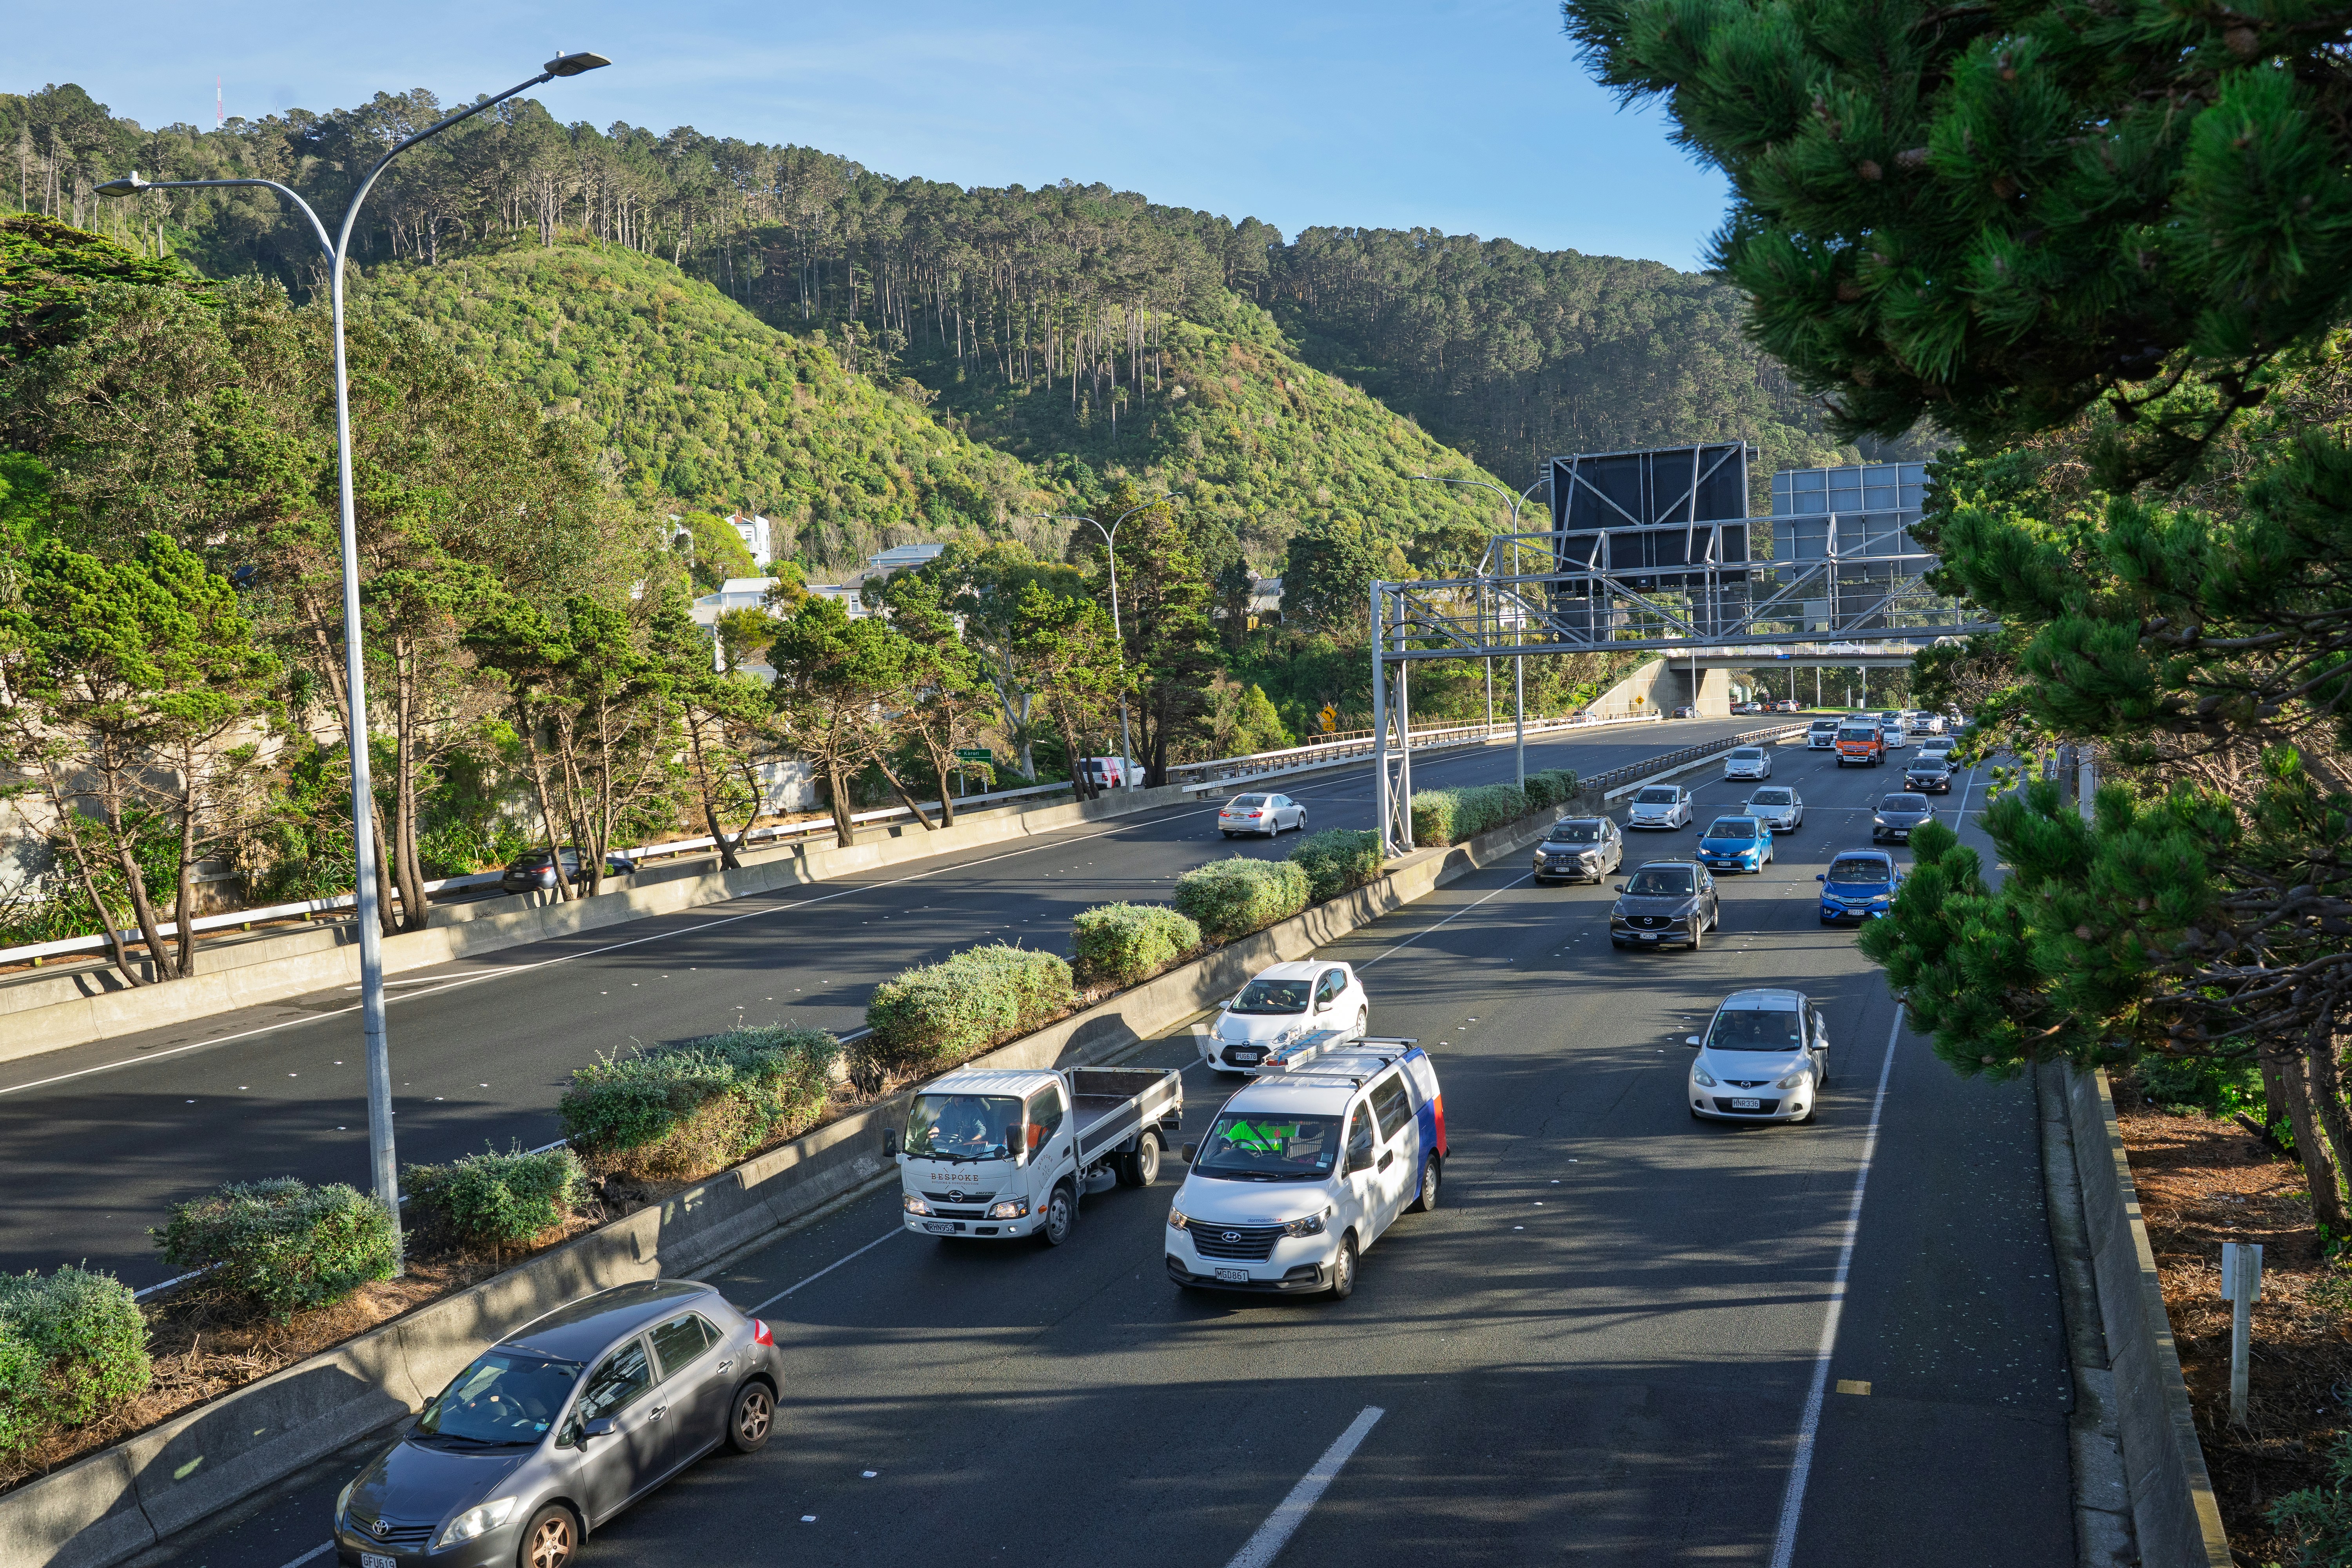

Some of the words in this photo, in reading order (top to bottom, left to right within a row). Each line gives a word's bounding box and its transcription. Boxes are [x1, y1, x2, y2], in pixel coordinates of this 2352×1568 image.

[931, 1173, 979, 1181] BESPOKE
[929, 1223, 954, 1232] RHN952
[1217, 1270, 1246, 1280] MGD861
[363, 1555, 395, 1568] GFU619
